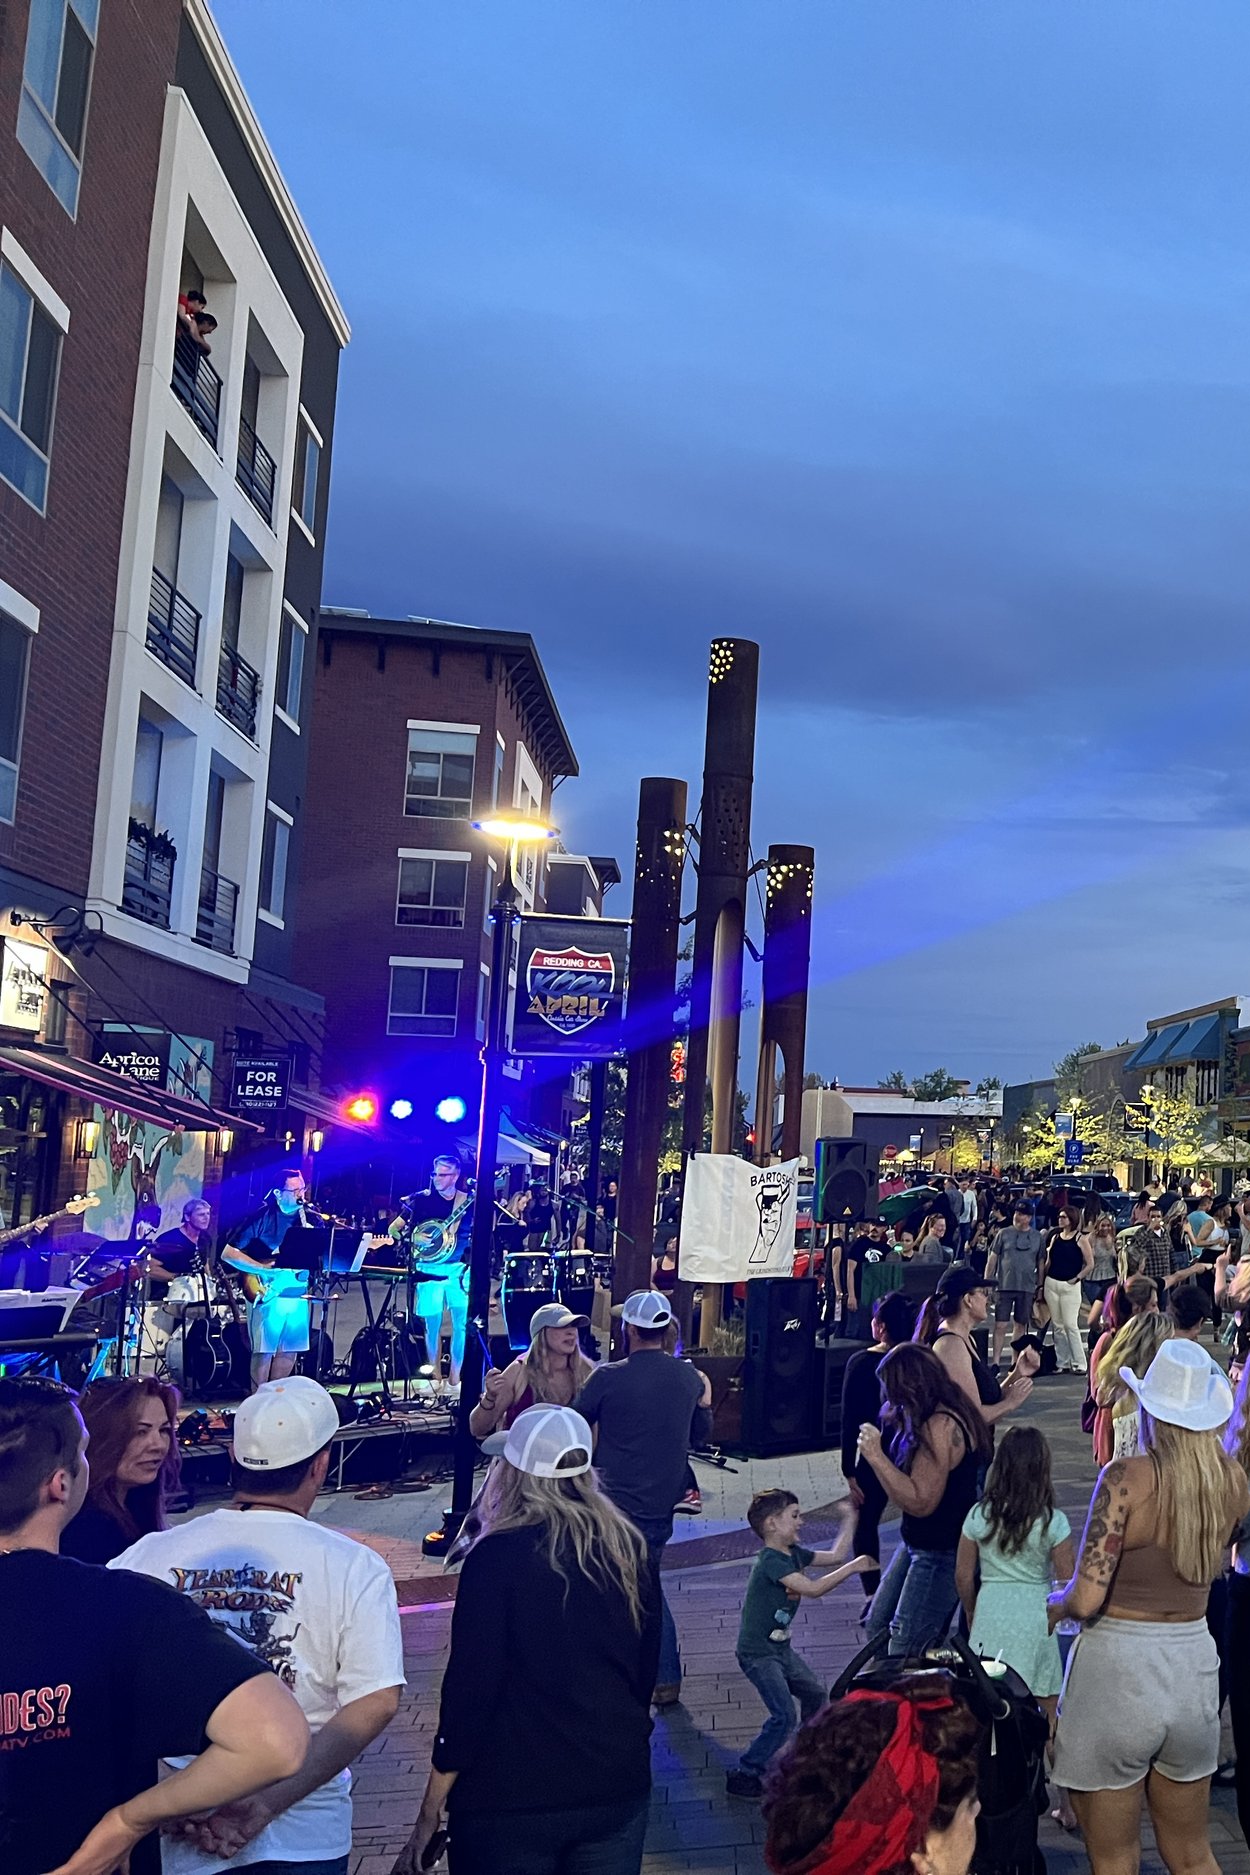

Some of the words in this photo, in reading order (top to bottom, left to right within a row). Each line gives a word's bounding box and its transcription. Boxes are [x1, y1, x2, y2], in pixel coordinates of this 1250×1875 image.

[543, 956, 584, 968] REDDING
[246, 1071, 277, 1082] FOR
[237, 1084, 283, 1097] LEASE
